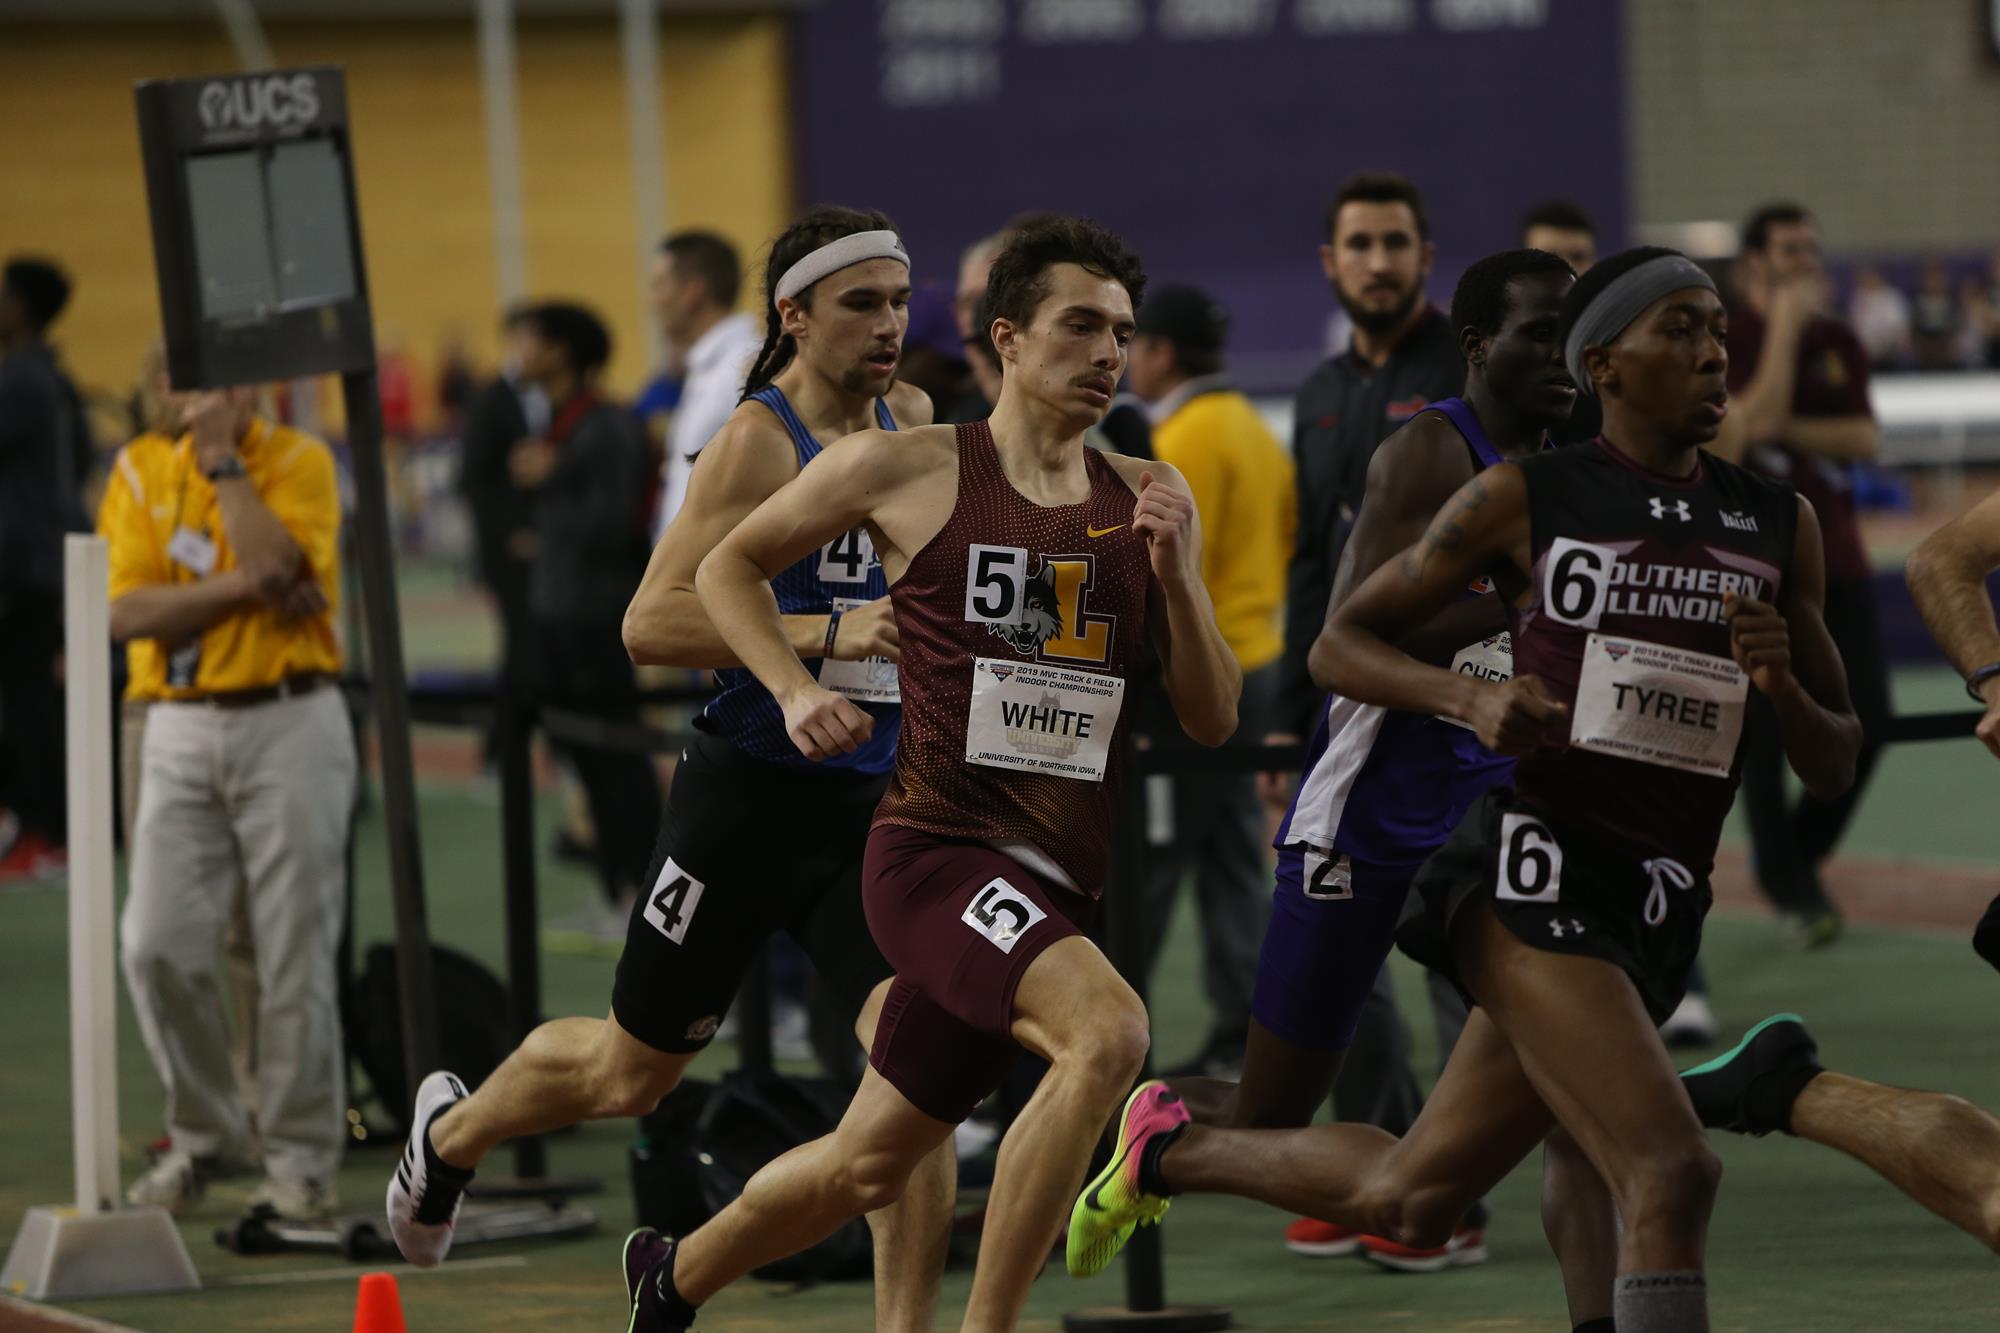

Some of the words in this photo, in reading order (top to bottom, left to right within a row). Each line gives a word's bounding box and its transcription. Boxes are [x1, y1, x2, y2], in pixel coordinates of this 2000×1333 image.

[236, 75, 319, 125] UCS
[827, 529, 863, 577] 4
[973, 550, 1016, 619] 5
[1551, 548, 1602, 619] 6
[1608, 561, 1764, 598] OUTHERN
[1606, 590, 1728, 626] LLINOI
[1501, 636, 1512, 644] 20
[1015, 676, 1048, 688] INDOOR
[1049, 681, 1114, 697] CHAMPIONSHIPS
[1017, 666, 1039, 676] 2019
[1040, 670, 1058, 680] MVC
[1060, 673, 1085, 683] TRACK
[1093, 679, 1114, 688] FIELD
[1001, 701, 1094, 738] WHITE
[1612, 683, 1720, 731] TYREE
[978, 752, 1027, 765] UNIVERSITY
[1027, 759, 1038, 767] OF
[1038, 761, 1077, 773] NORTHERN
[1077, 766, 1096, 776] IOWA
[1309, 847, 1343, 894] 2
[1507, 822, 1554, 896] 6
[653, 875, 692, 933] 4
[971, 886, 1030, 941] 5
